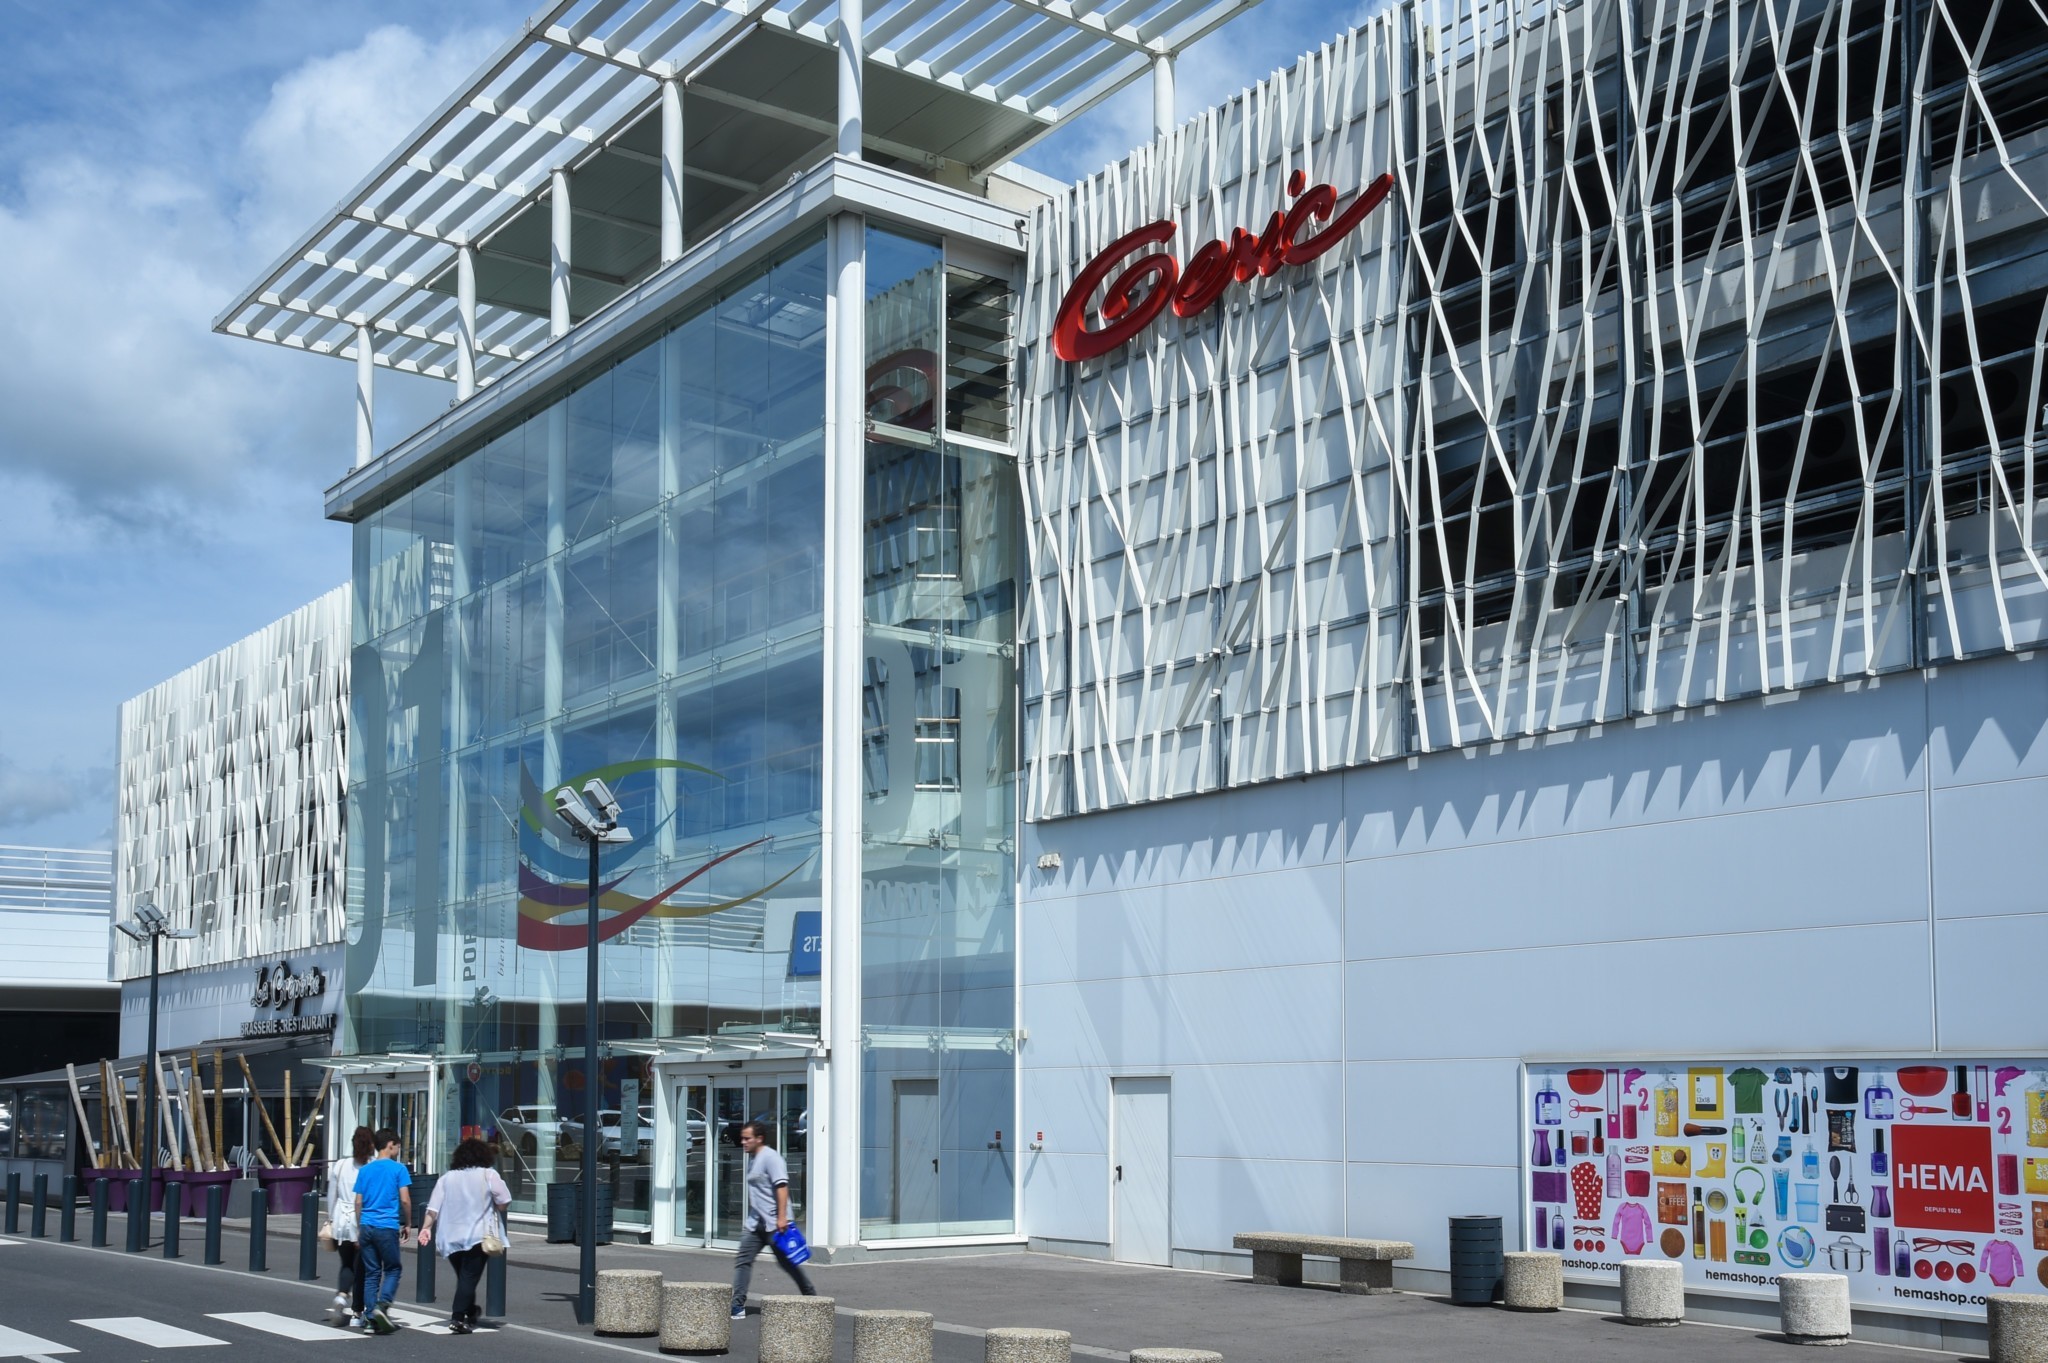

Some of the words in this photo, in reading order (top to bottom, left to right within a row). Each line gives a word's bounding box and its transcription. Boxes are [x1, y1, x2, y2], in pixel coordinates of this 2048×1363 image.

[240, 1019, 278, 1037] BRASSERIE
[283, 1014, 333, 1034] RESTAURANT
[1898, 1163, 1988, 1193] HEMA
[1705, 1269, 1780, 1286] hemashop.co
[1894, 1286, 1987, 1306] hemashop.co
